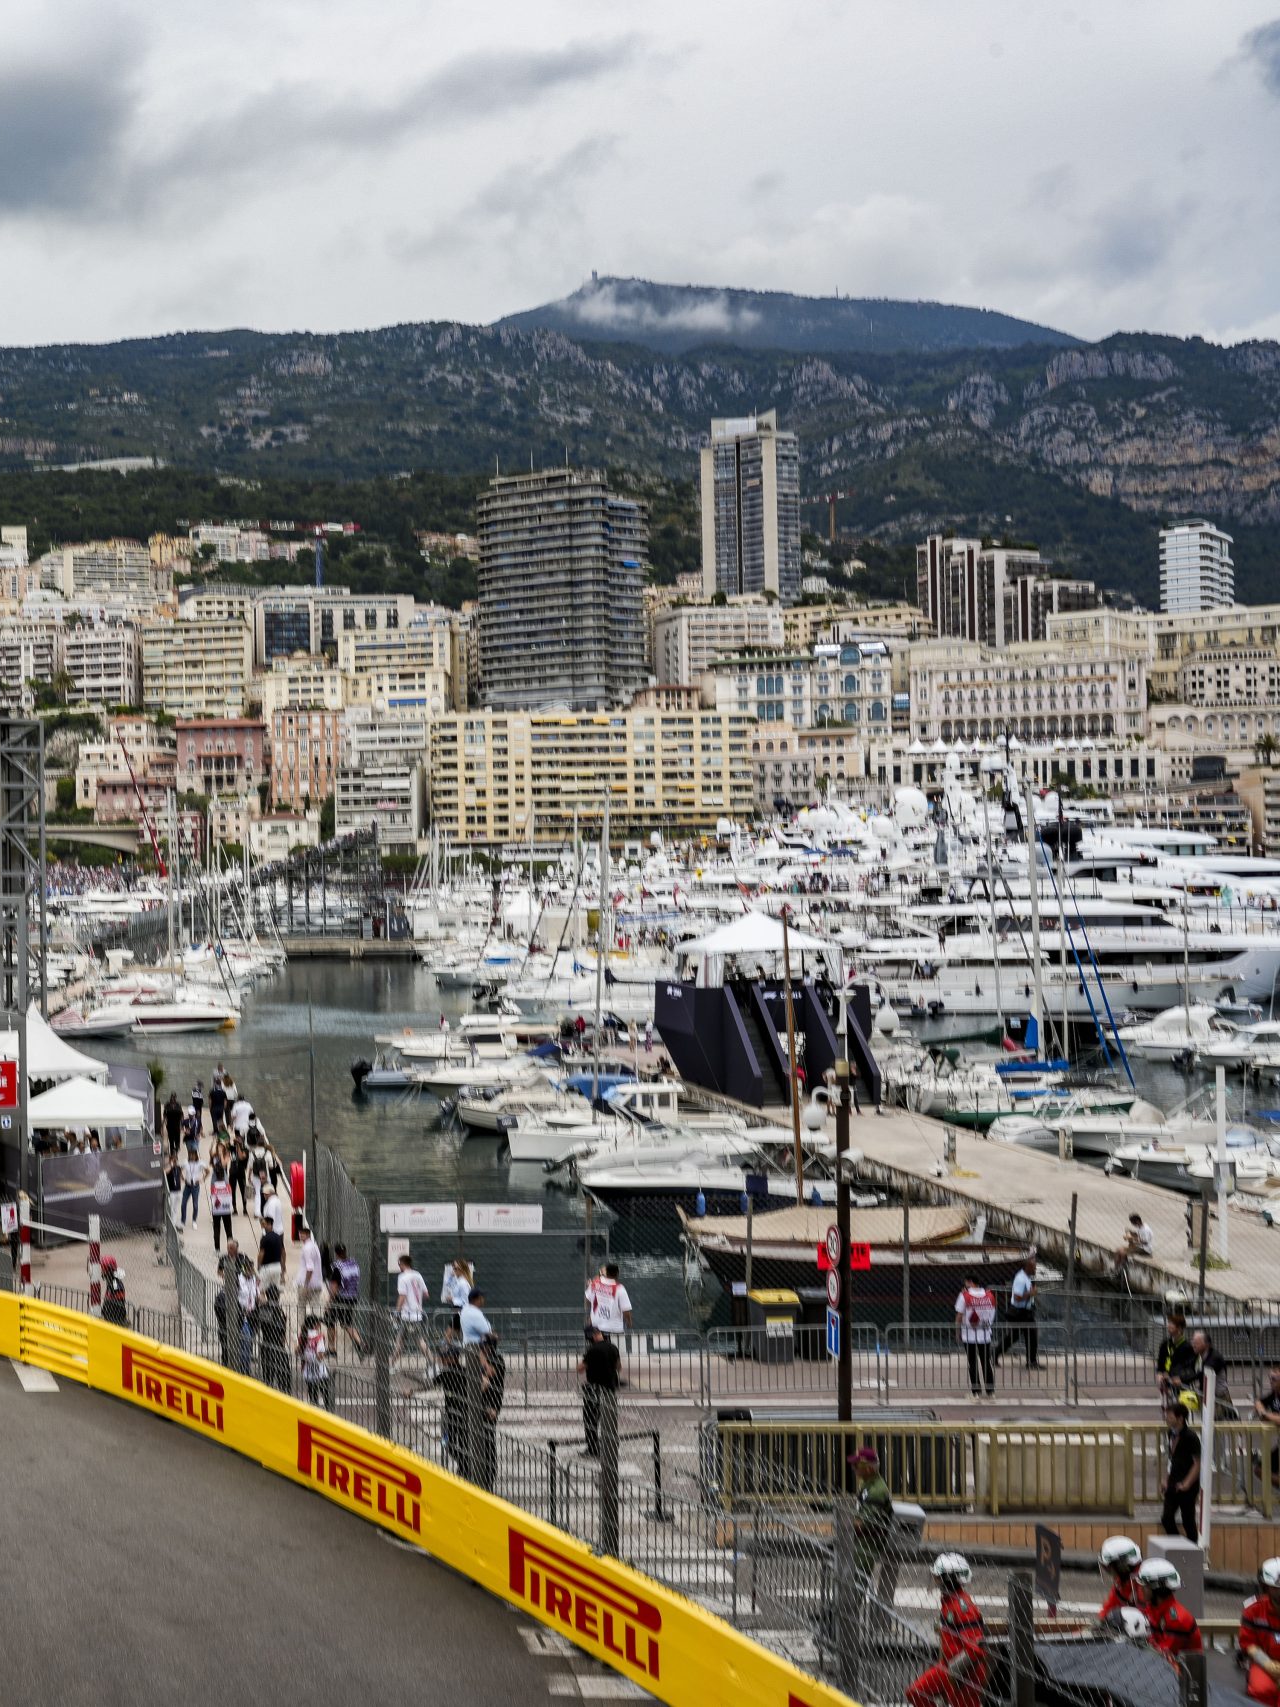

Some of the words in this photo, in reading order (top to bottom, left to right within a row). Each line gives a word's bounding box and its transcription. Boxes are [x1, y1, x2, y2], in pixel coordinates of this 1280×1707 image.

[122, 1344, 224, 1433] PIRELLI
[297, 1419, 422, 1535] PIRELLI
[508, 1526, 662, 1682] PIRELLI
